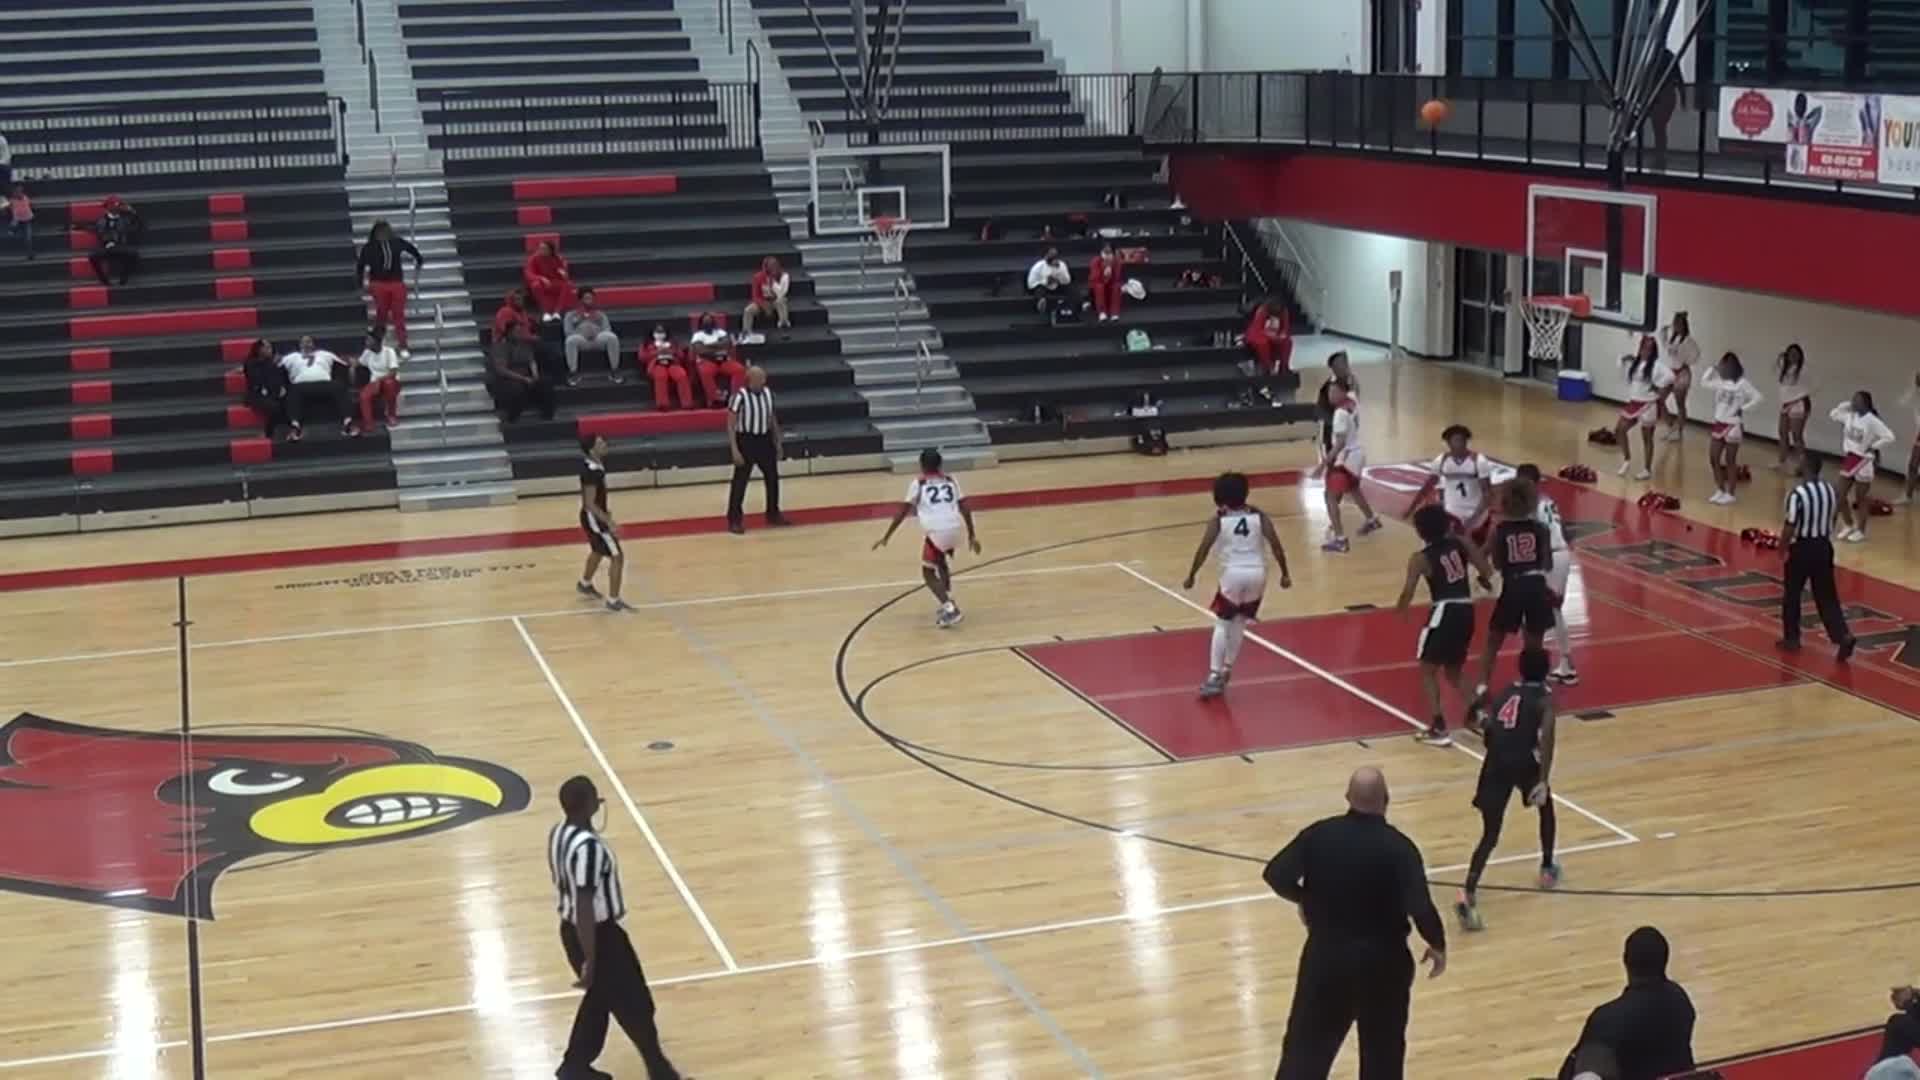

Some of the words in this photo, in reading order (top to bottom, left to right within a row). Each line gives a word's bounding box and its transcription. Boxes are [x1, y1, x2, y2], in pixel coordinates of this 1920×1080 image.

[926, 484, 954, 504] 23
[1456, 482, 1467, 497] 1
[1233, 517, 1250, 537] 4
[1506, 532, 1537, 563] 12
[1440, 551, 1464, 583] 11
[1498, 695, 1521, 729] 4
